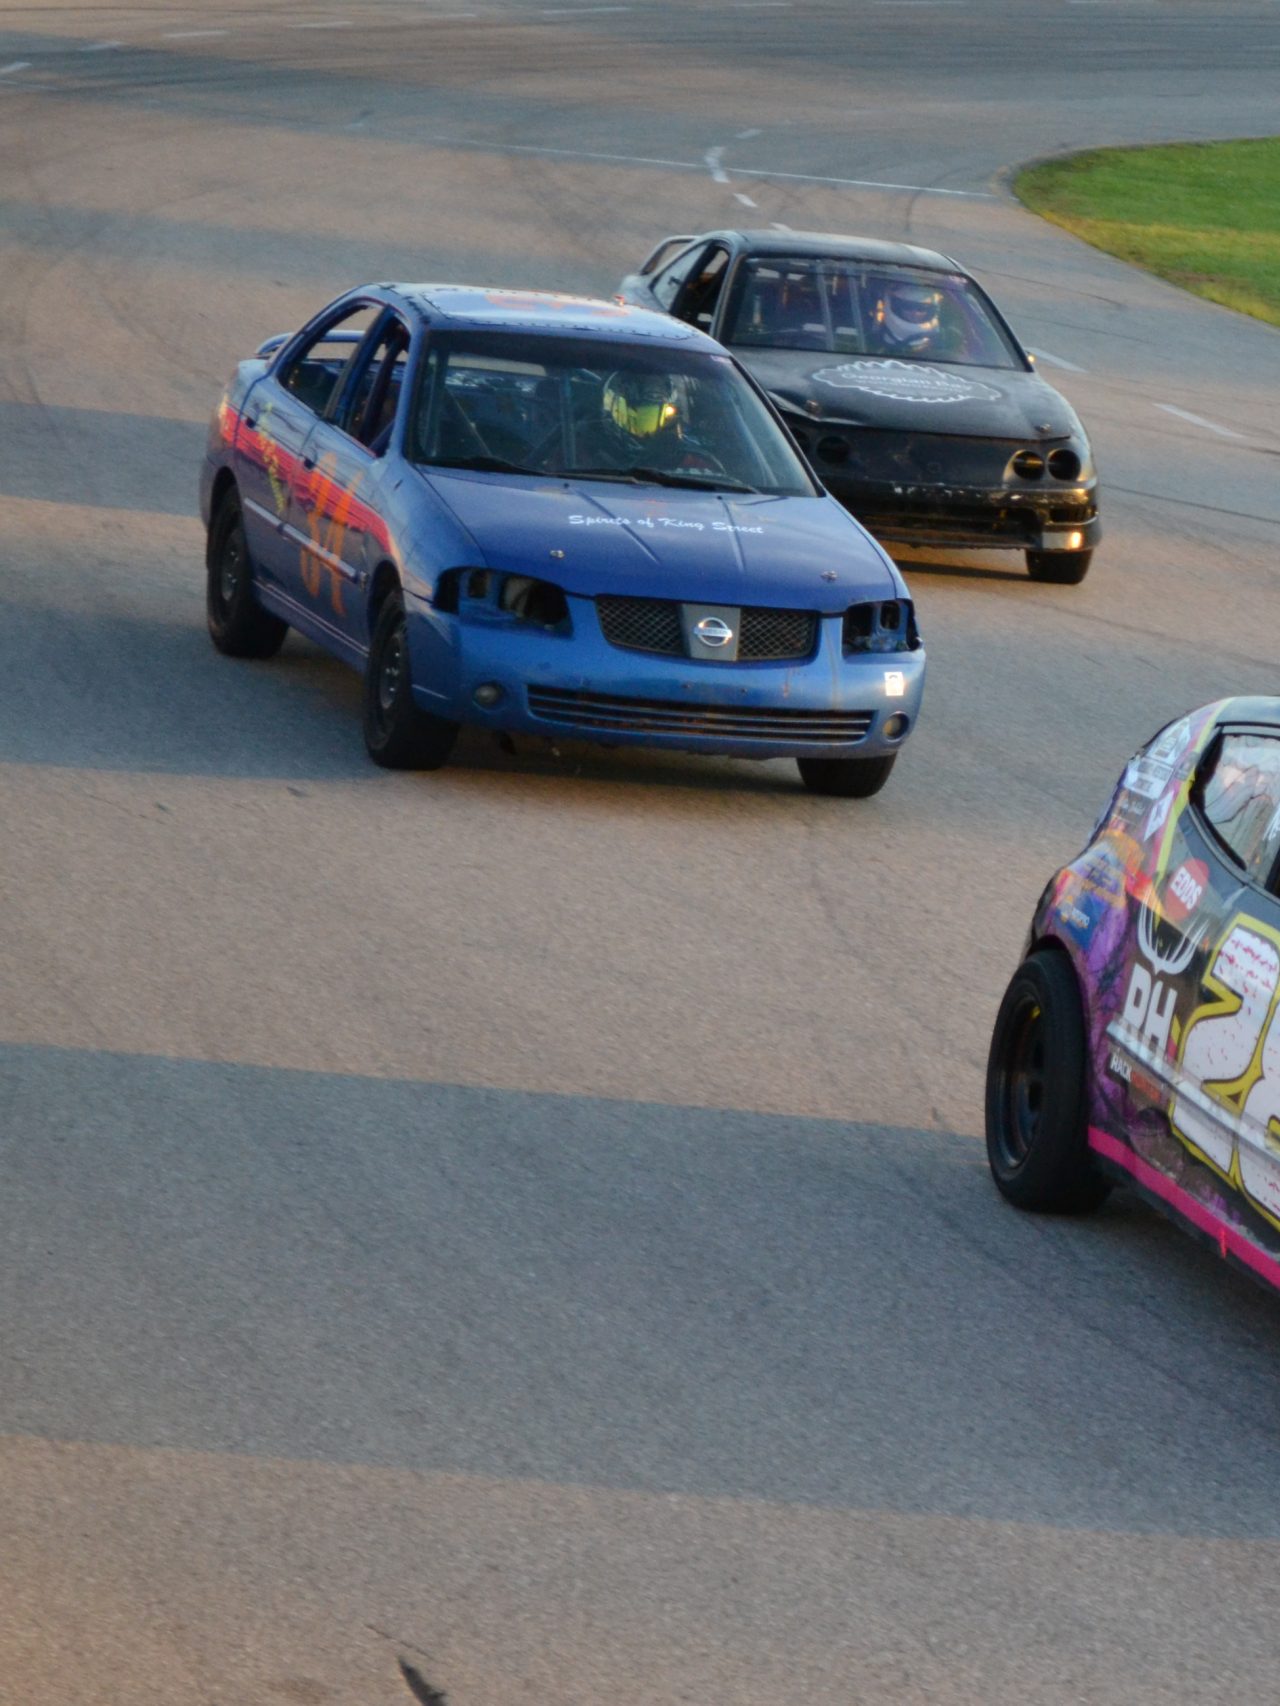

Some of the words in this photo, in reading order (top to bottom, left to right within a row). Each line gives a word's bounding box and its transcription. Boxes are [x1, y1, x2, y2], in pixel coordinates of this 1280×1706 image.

[568, 514, 632, 526] Spirits
[636, 517, 655, 528] of
[657, 517, 705, 531] King
[711, 521, 765, 534] Street
